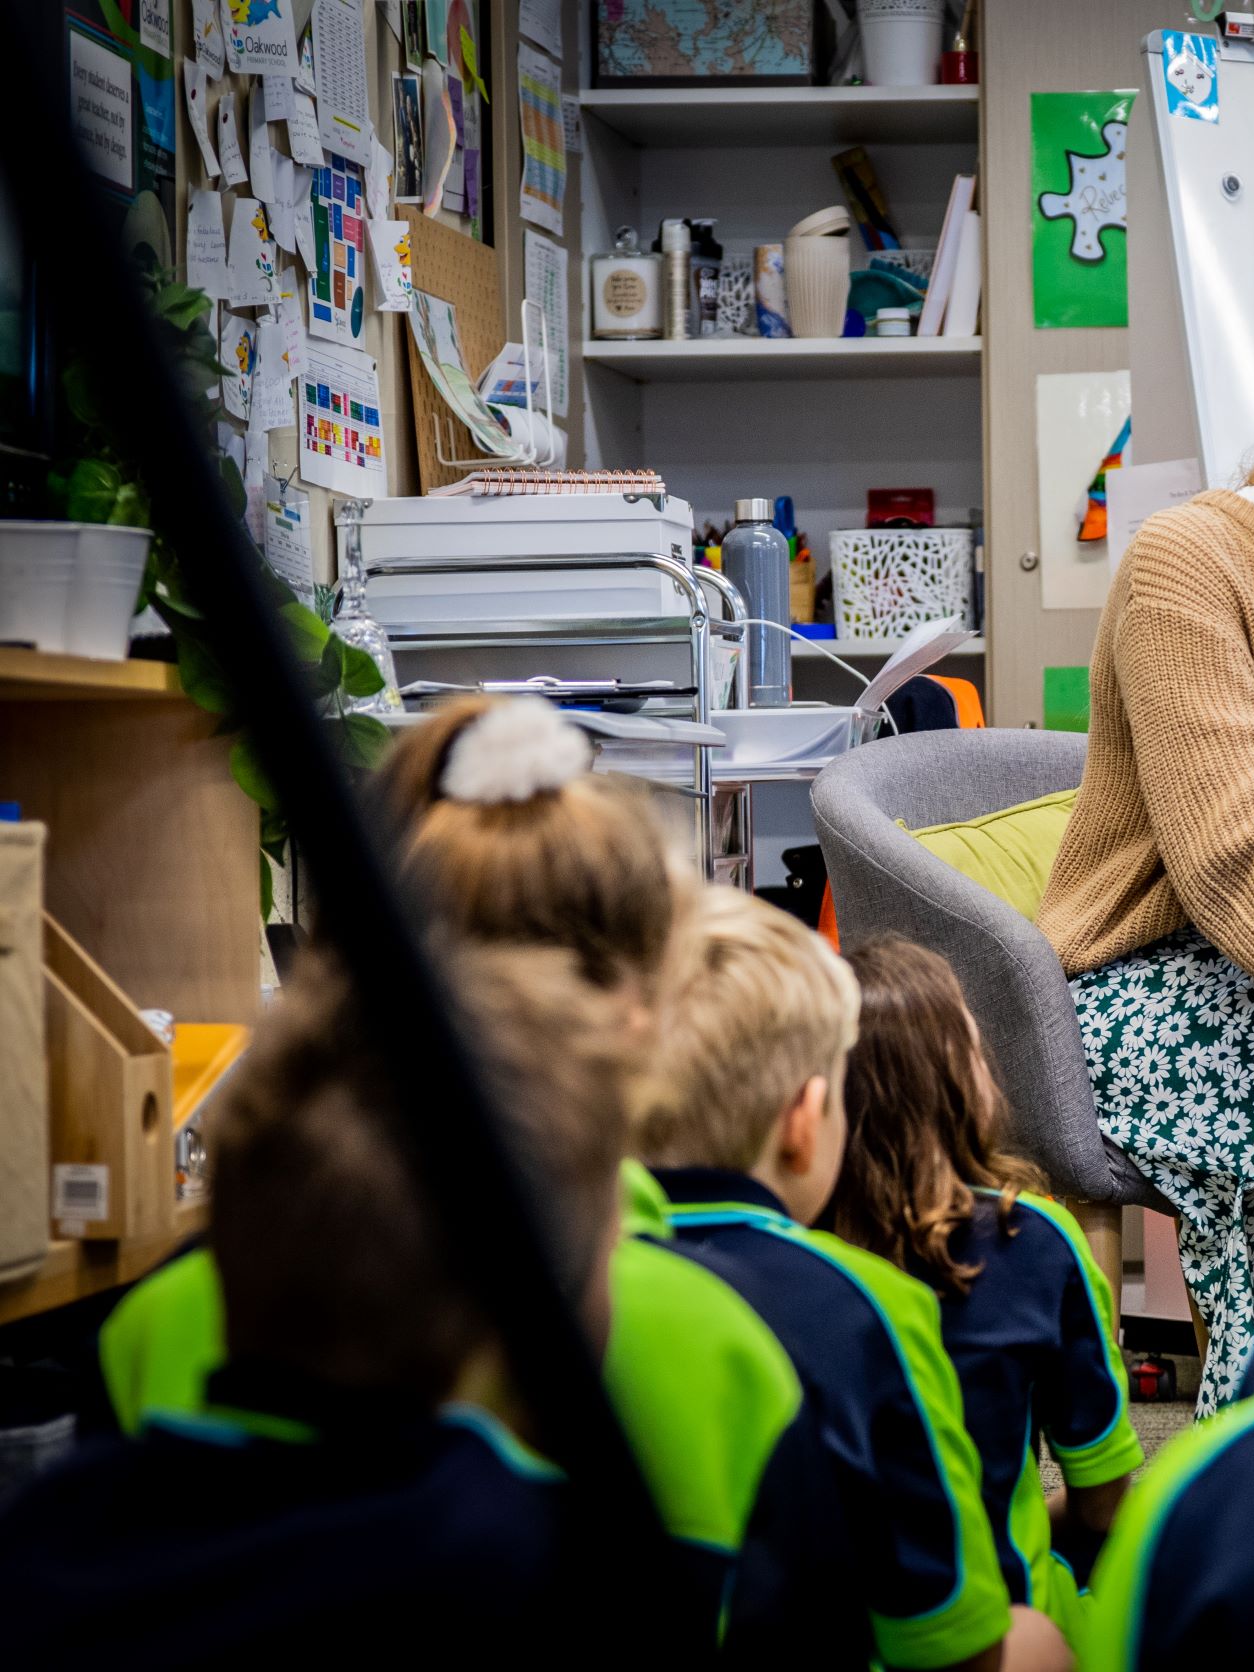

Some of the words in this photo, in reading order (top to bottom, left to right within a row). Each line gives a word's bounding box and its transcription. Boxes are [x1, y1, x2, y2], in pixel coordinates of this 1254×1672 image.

[245, 36, 288, 57] Oakwood
[247, 55, 267, 65] PRIMARY
[268, 58, 286, 67] SCHOOL
[73, 60, 87, 90] Every
